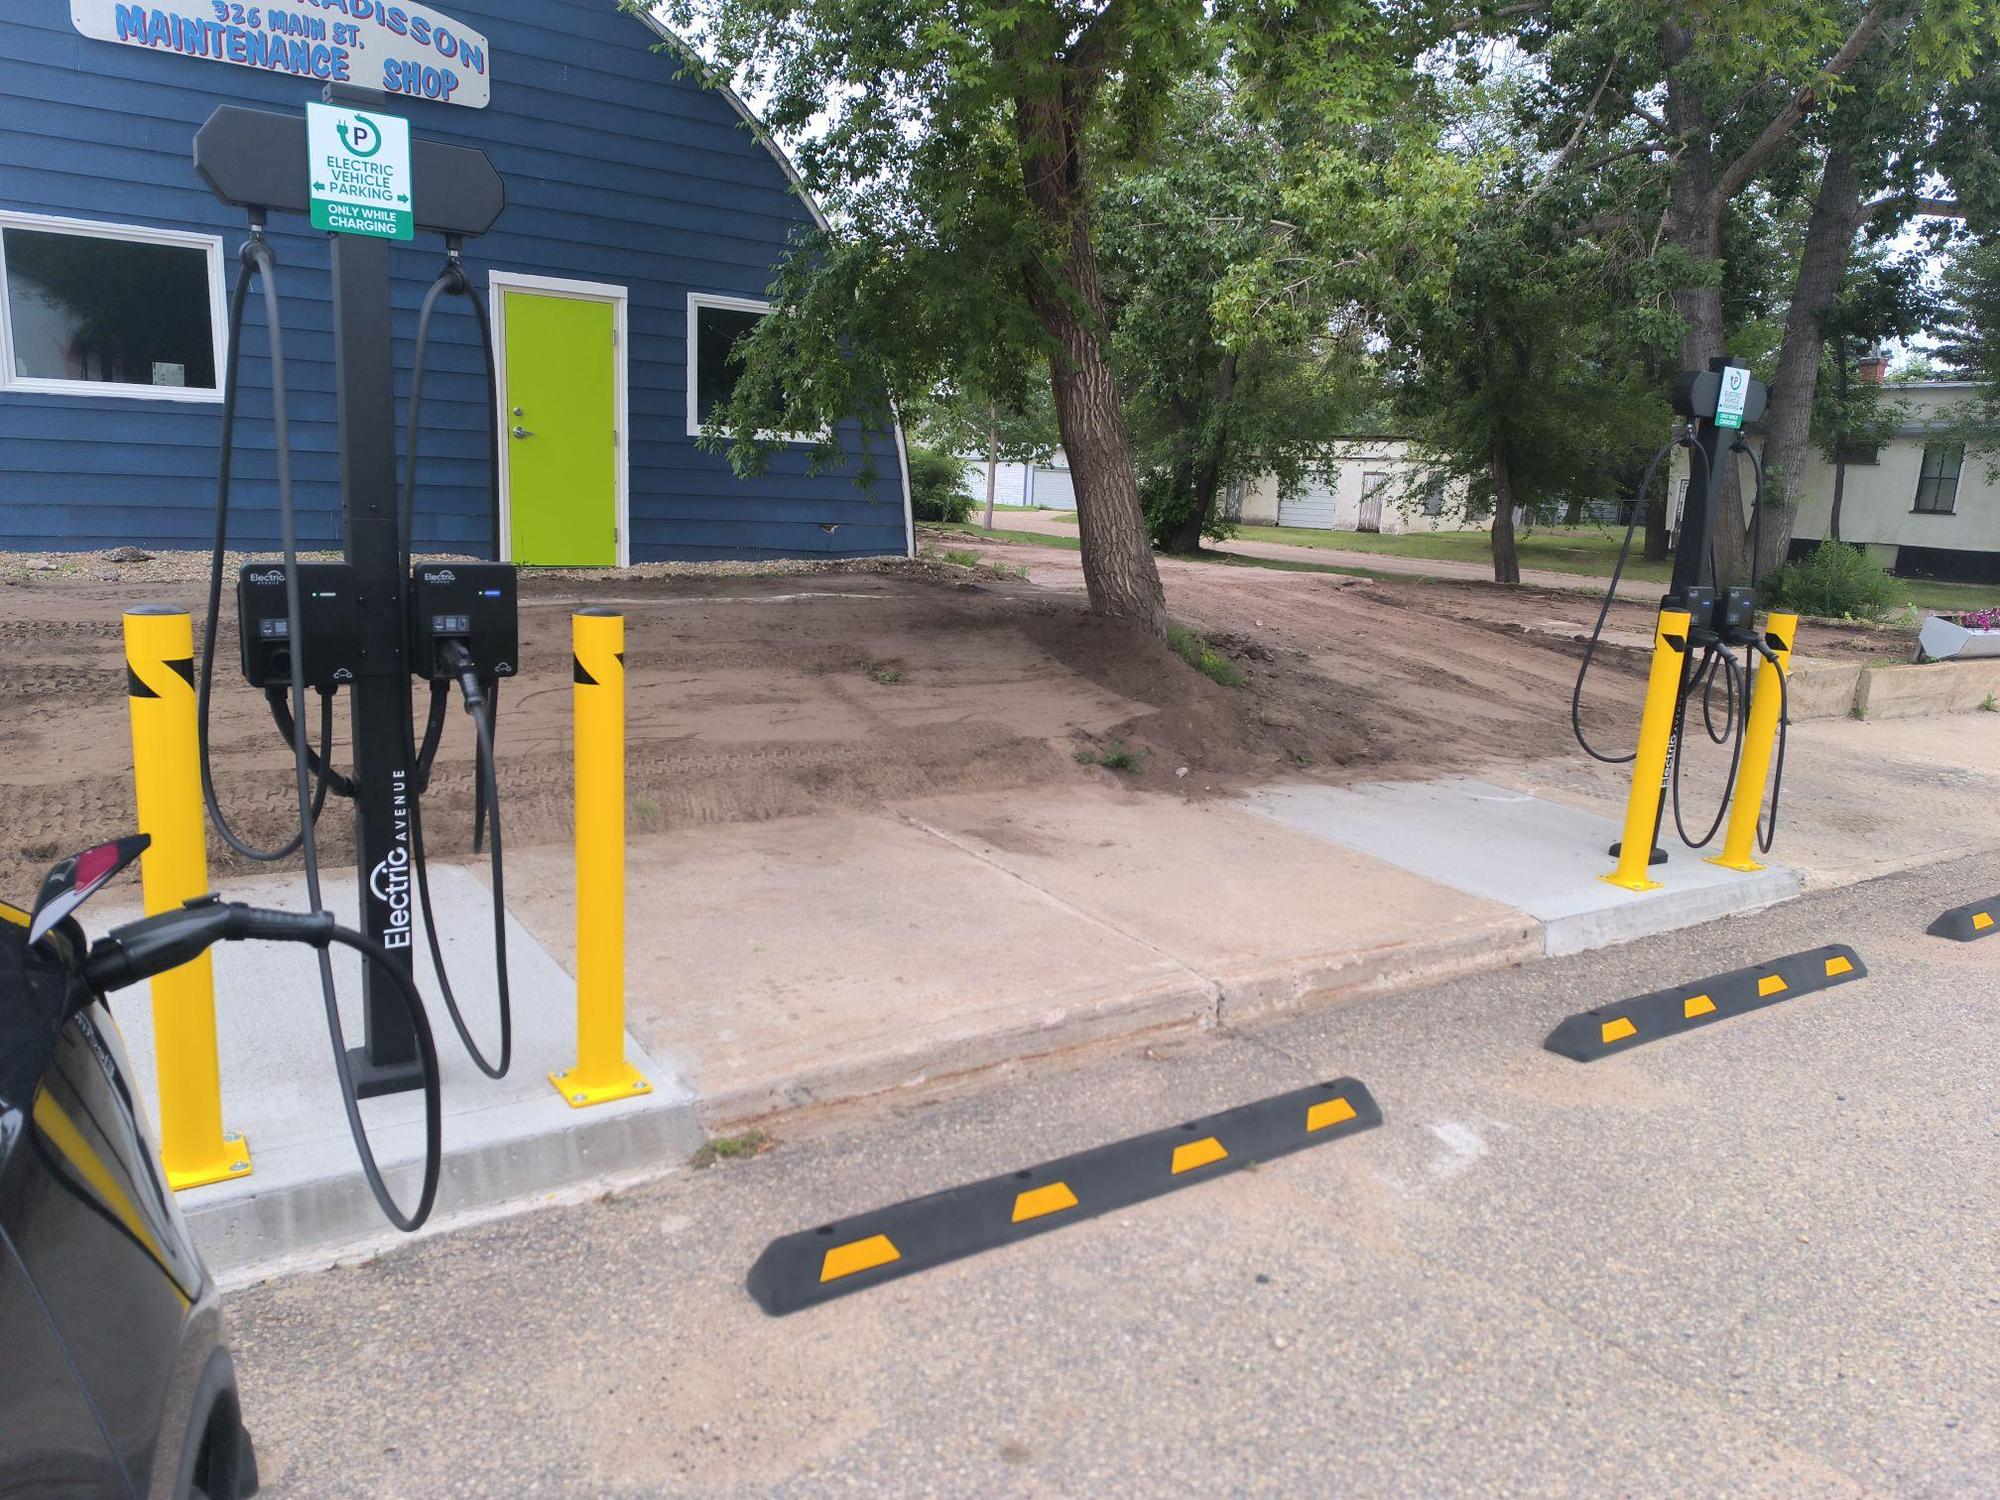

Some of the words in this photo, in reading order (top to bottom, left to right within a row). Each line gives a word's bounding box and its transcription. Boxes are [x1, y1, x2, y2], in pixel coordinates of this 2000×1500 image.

[212, 0, 262, 28] 326
[268, 9, 326, 41] MAIN
[332, 22, 365, 49] ST.
[297, 0, 484, 74] ADISSON
[115, 3, 350, 81] MAINTENANCE
[383, 58, 459, 101] SHOP
[353, 126, 368, 145] P
[327, 155, 394, 177] ELECTRIC
[331, 169, 391, 189] VEHICLE
[329, 181, 394, 201] PARKING
[328, 203, 360, 217] ONLY
[361, 208, 397, 222] WHILE
[328, 216, 397, 234] CHARGING
[392, 770, 408, 841] AVENUE
[381, 847, 411, 949] Electric
